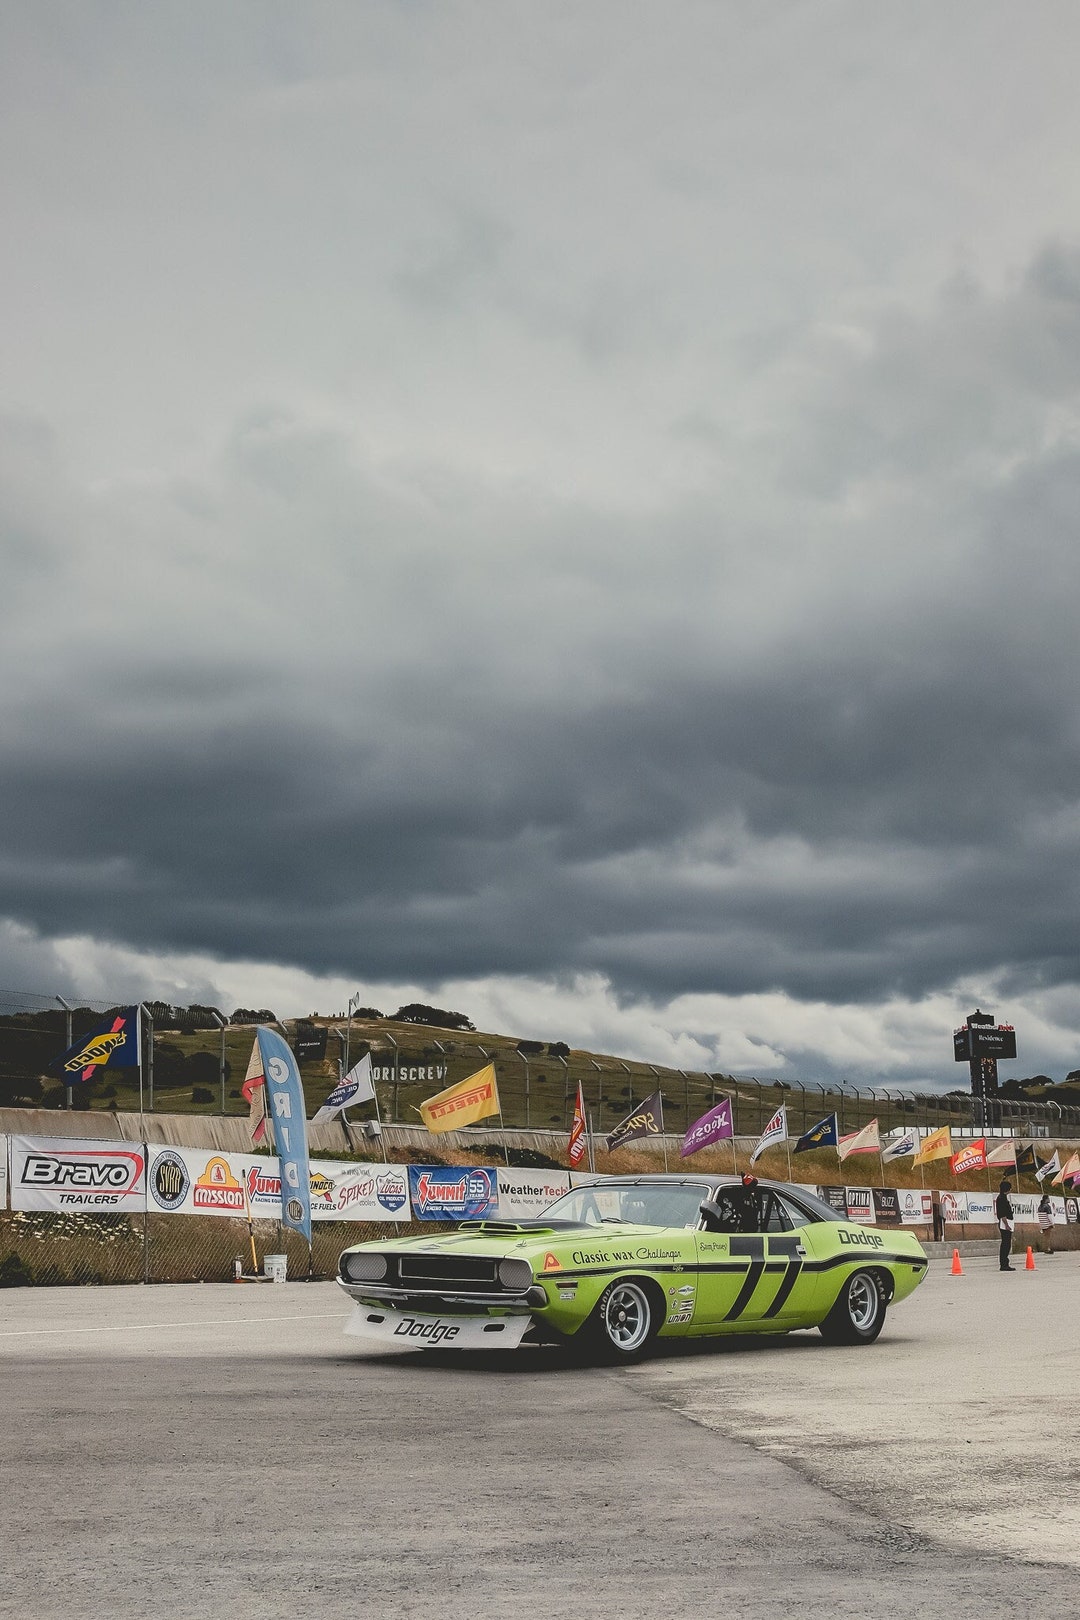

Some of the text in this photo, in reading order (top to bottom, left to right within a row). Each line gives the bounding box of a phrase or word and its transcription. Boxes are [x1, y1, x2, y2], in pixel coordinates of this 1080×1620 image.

[21, 1156, 129, 1186] Bravo
[337, 1179, 375, 1210] SPIKED
[379, 1183, 404, 1194] LUCAS
[469, 1179, 484, 1193] 55
[59, 1194, 119, 1204] TRAILERS
[319, 1203, 337, 1211] FUELS
[837, 1229, 884, 1249] Dodge
[572, 1247, 682, 1265] Classic wax Challenger
[728, 1236, 802, 1322] 77
[393, 1318, 460, 1344] Dodge
